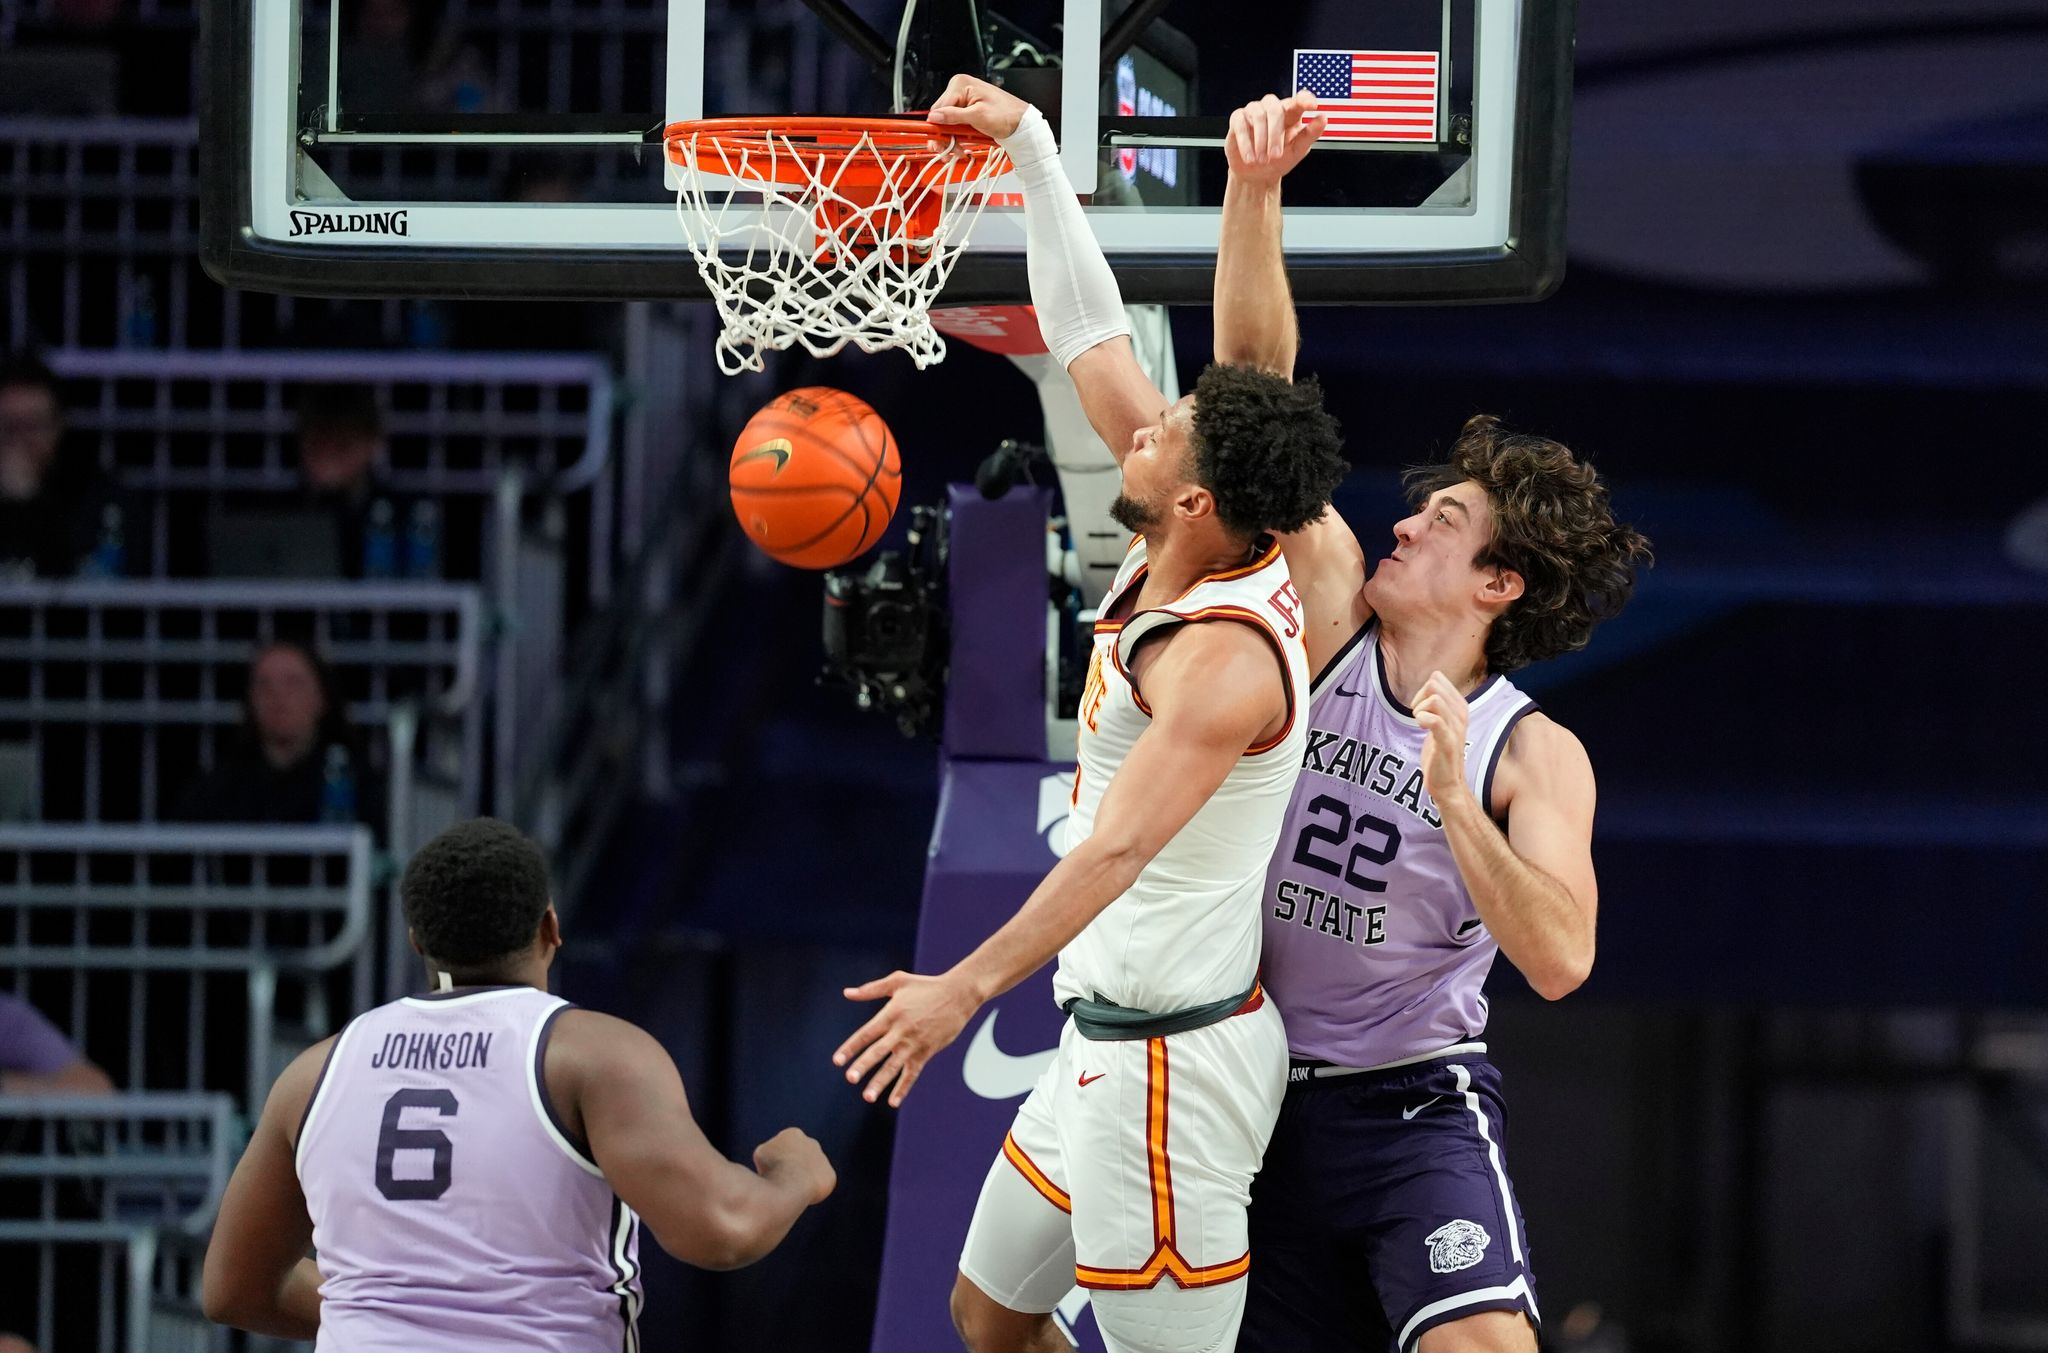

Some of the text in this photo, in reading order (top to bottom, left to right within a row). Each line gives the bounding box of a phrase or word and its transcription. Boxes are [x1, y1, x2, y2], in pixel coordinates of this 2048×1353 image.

[289, 209, 408, 237] SPALDING
[1292, 793, 1402, 892] 22
[1274, 879, 1388, 946] STATE
[371, 1031, 493, 1070] JOHNSON
[374, 1087, 459, 1201] 6
